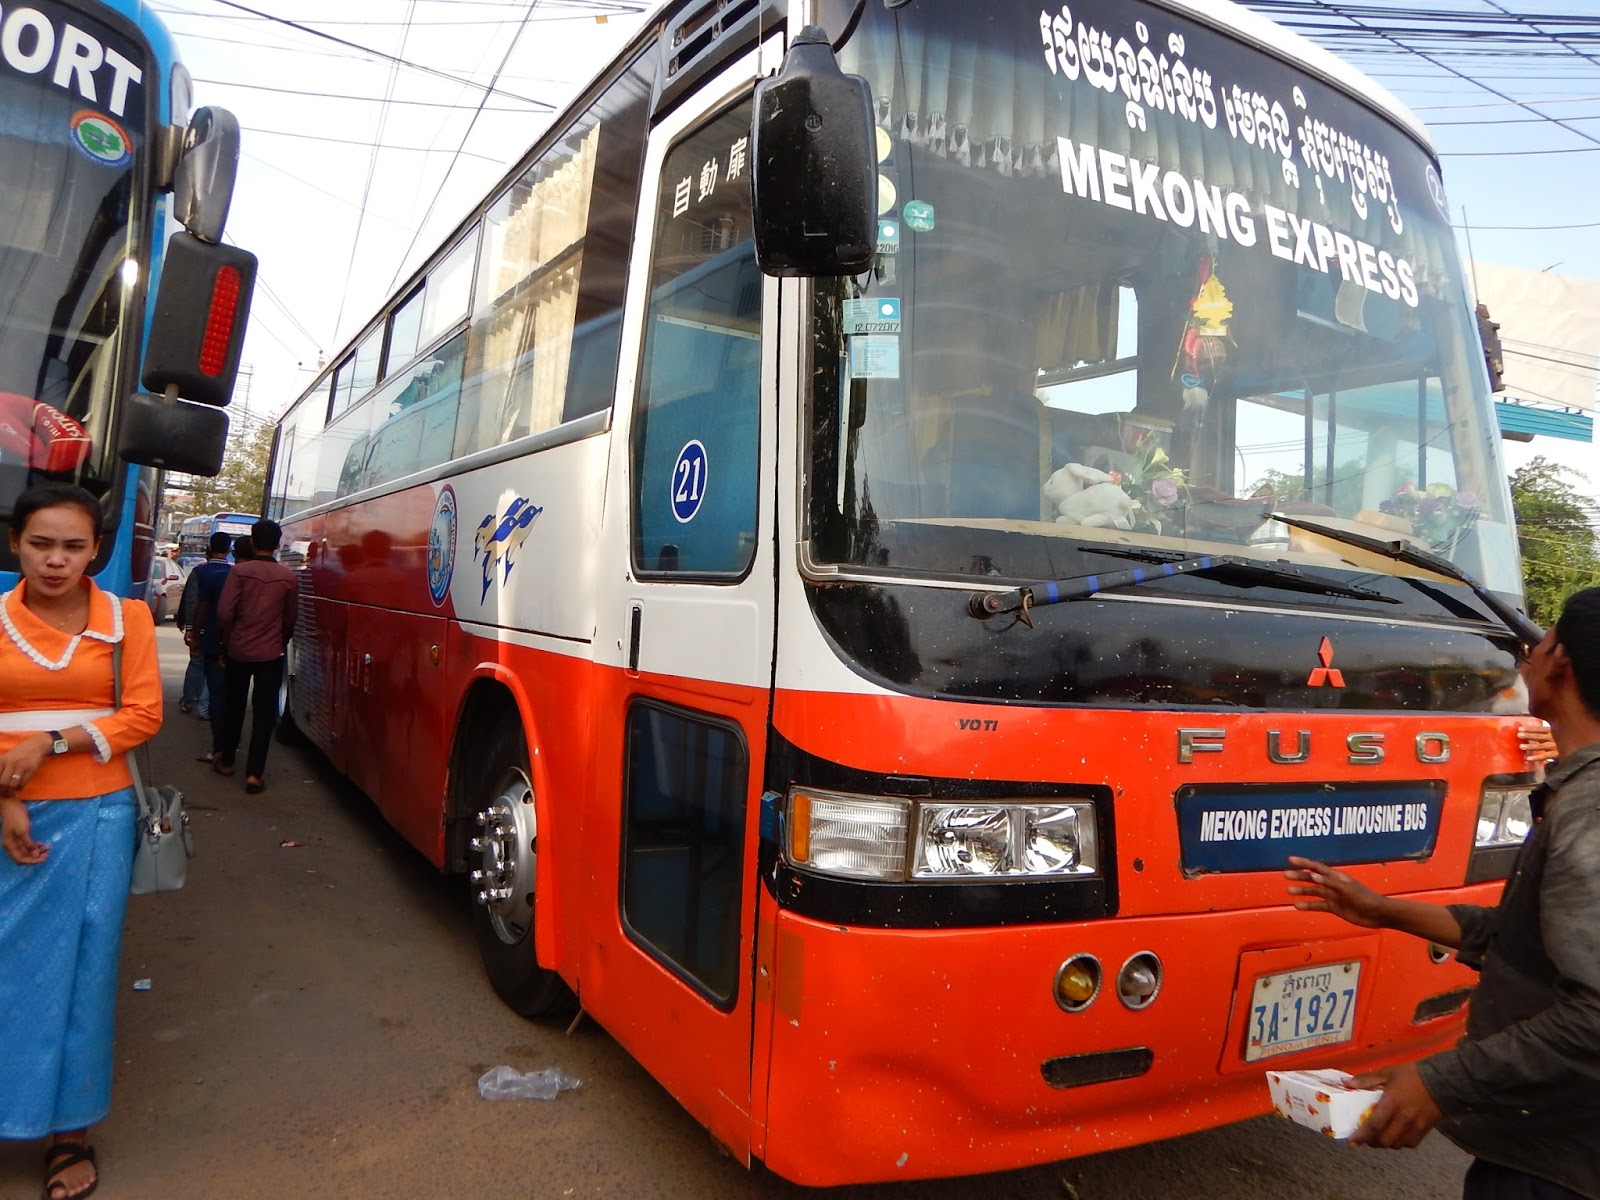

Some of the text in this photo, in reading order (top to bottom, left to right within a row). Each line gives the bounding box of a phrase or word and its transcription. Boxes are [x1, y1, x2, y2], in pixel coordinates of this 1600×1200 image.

[0, 6, 143, 118] ORT
[673, 136, 748, 219] 自動扉
[1057, 136, 1419, 308] MEKONG EXPRESS
[675, 456, 701, 502] 21
[1177, 728, 1451, 764] FUSO
[1200, 802, 1427, 842] MEKONG EXPRESS LIMOUSINE BUS
[1252, 989, 1354, 1042] 3A-1927
